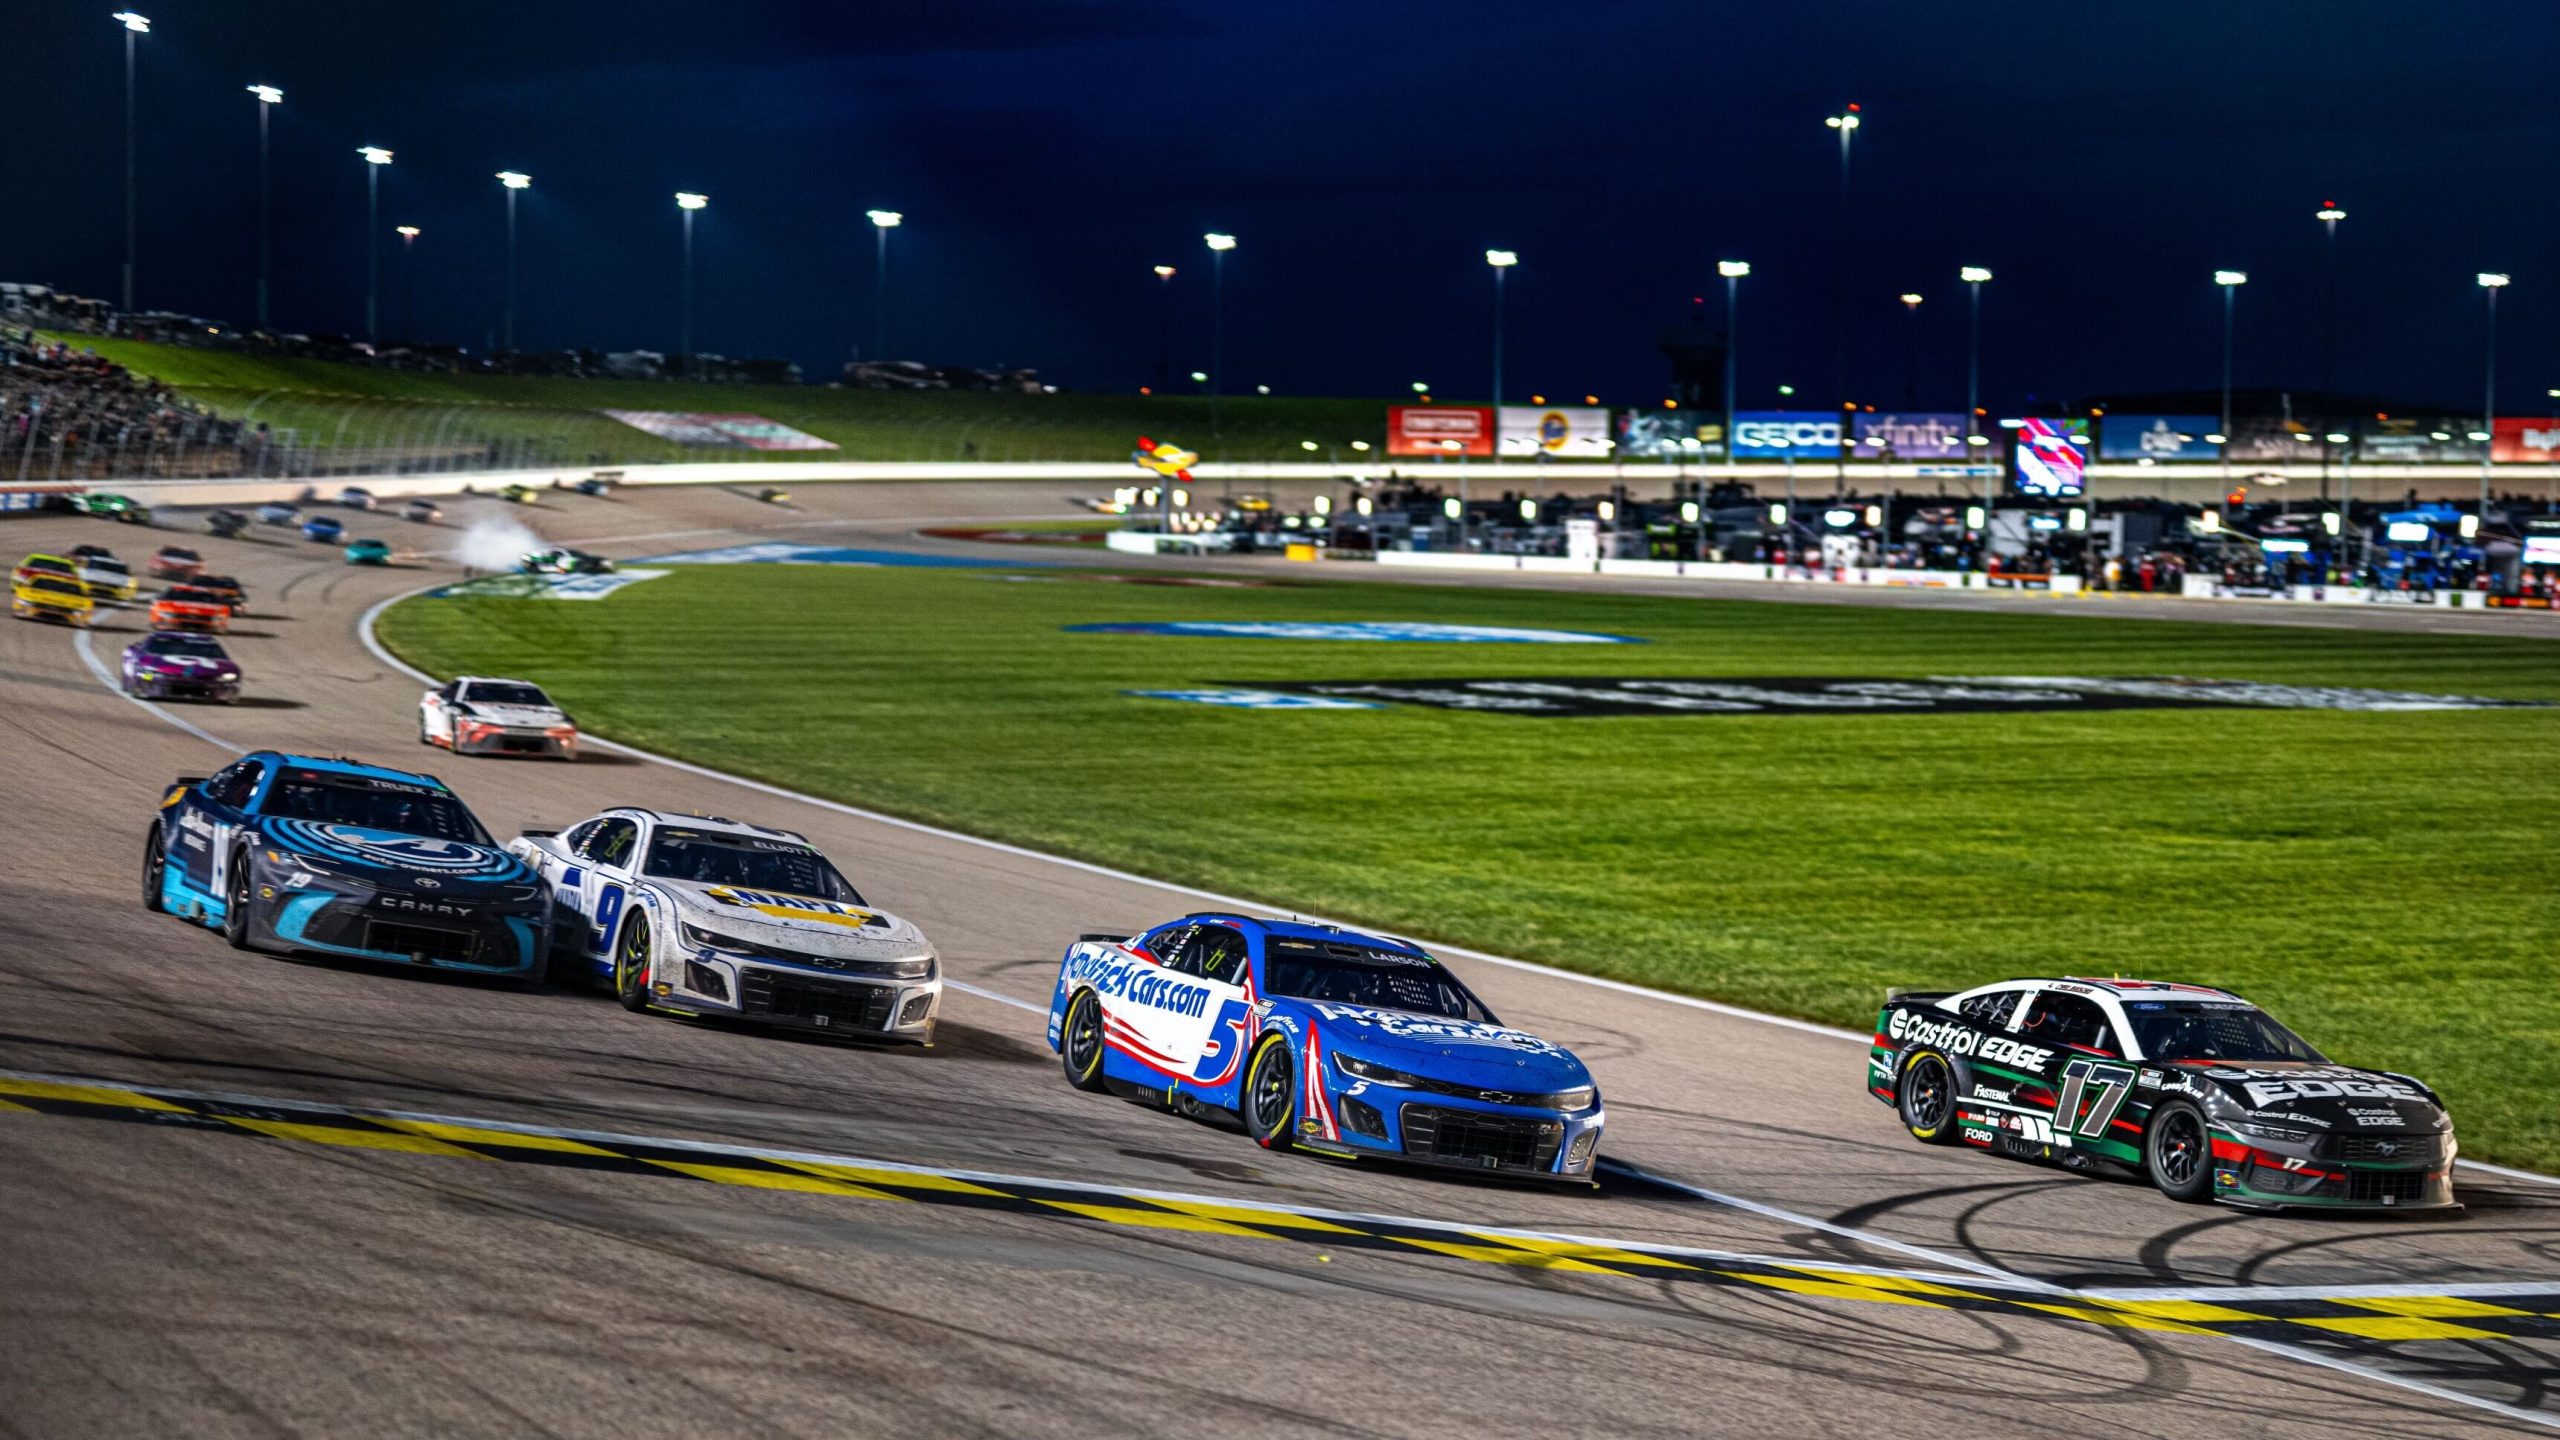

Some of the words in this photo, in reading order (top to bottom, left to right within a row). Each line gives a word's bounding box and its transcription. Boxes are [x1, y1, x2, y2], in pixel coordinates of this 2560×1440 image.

[1736, 422, 1841, 446] GEICO
[367, 779, 427, 795] TRUEX
[753, 840, 811, 857] ELLIOTT
[362, 853, 480, 874] auto-owners.com
[285, 871, 313, 888] 19
[381, 897, 473, 917] CAMRY
[728, 888, 848, 916] NAPA
[586, 882, 625, 956] 9
[1368, 951, 1432, 968] LARSON
[1190, 998, 1253, 1080] 5
[1903, 1013, 1981, 1056] Castrol
[1978, 1036, 2055, 1073] EDGE
[1347, 1081, 1370, 1096] 5
[2243, 1081, 2429, 1107] EDGE
[2055, 1059, 2136, 1138] 17
[2256, 1110, 2286, 1120] Castrol
[2288, 1112, 2333, 1129] EDGE
[2357, 1116, 2406, 1127] EDGE
[2359, 1108, 2398, 1117] Castrol
[1964, 1127, 1993, 1142] FORD
[2282, 1157, 2307, 1171] 17
